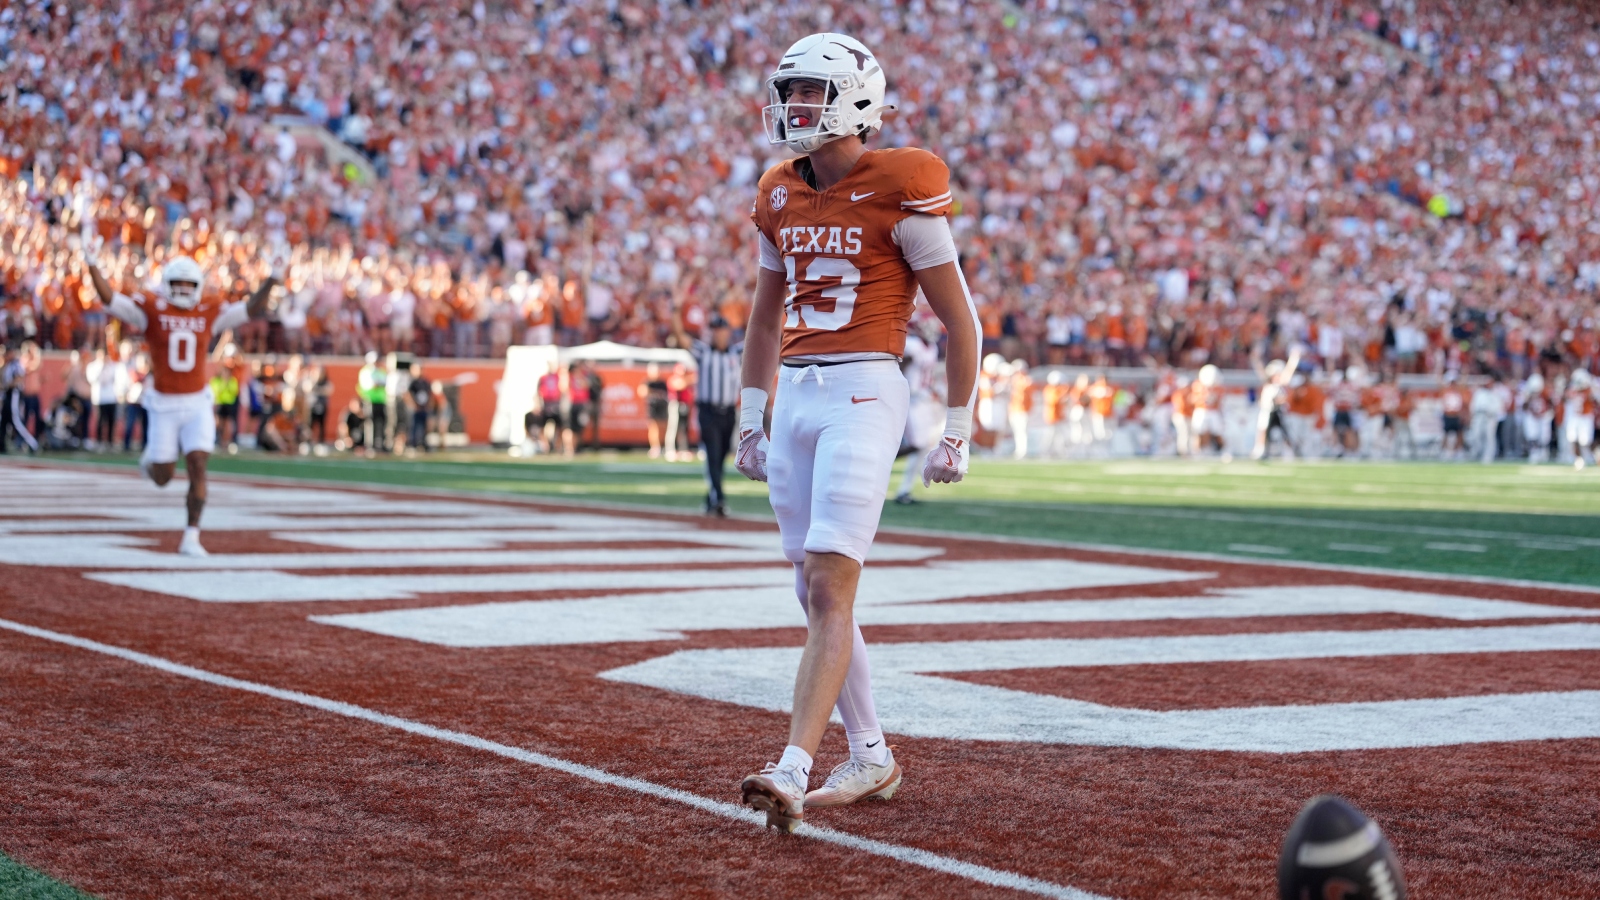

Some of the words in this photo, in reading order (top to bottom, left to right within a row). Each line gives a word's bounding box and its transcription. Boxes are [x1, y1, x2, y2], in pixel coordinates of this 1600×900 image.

[771, 187, 787, 209] SEC
[779, 226, 863, 255] TEXAS
[783, 255, 861, 331] 13
[158, 314, 206, 333] TEXAS
[168, 330, 197, 372] 0
